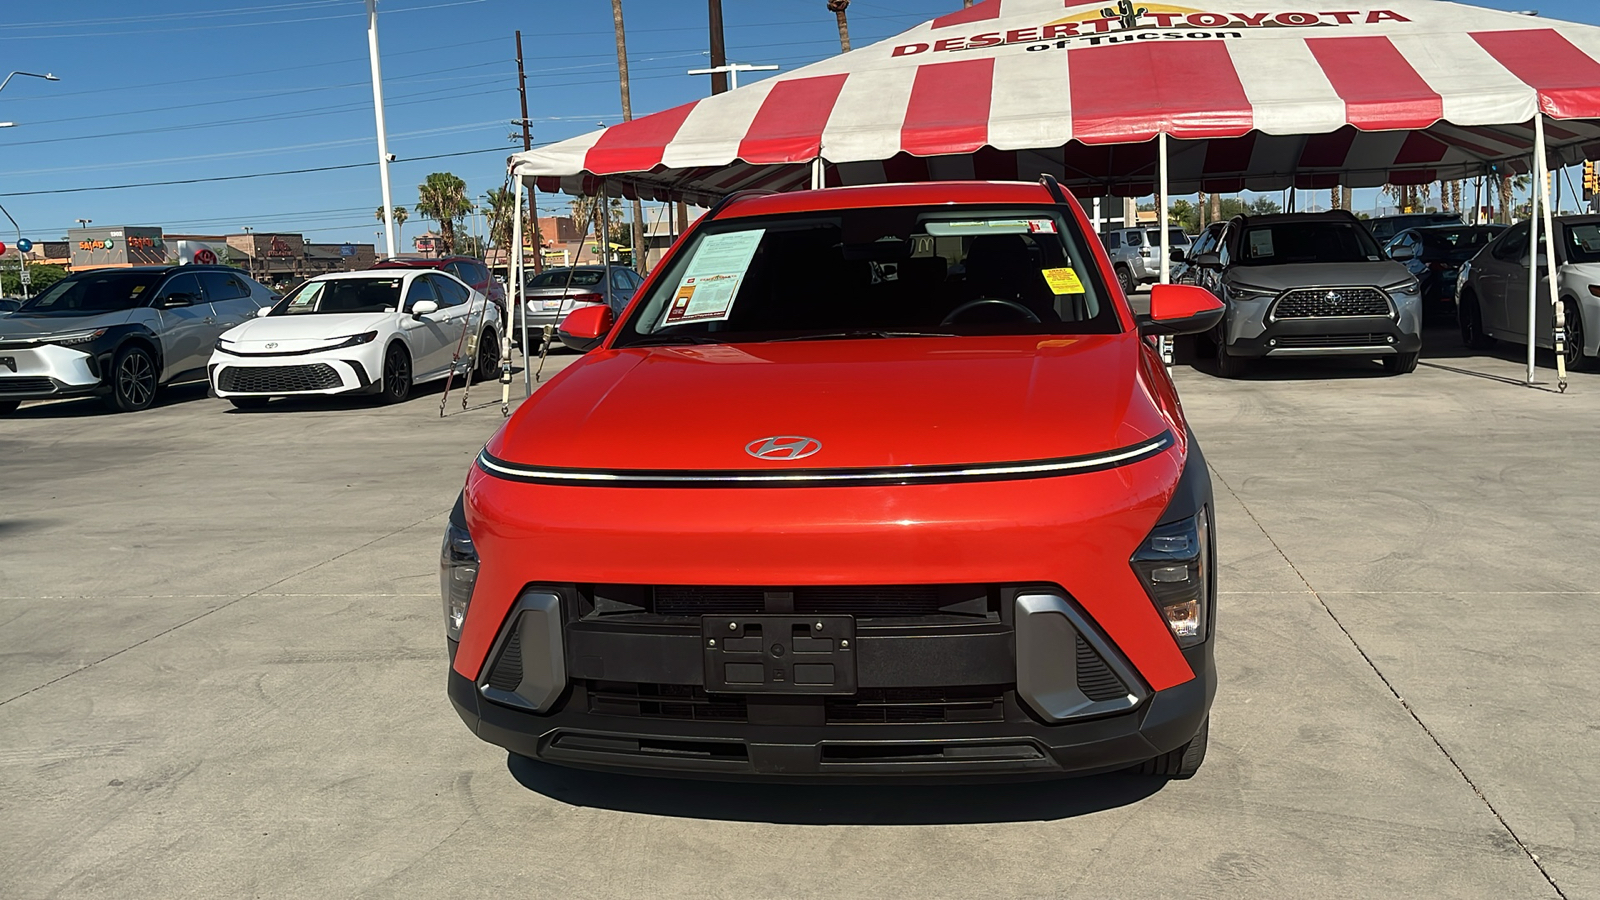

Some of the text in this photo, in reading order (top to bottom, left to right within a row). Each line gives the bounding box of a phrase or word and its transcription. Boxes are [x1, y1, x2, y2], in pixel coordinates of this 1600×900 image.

[891, 9, 1413, 57] DESERT TOYOTA
[1026, 30, 1242, 52] of Tucson
